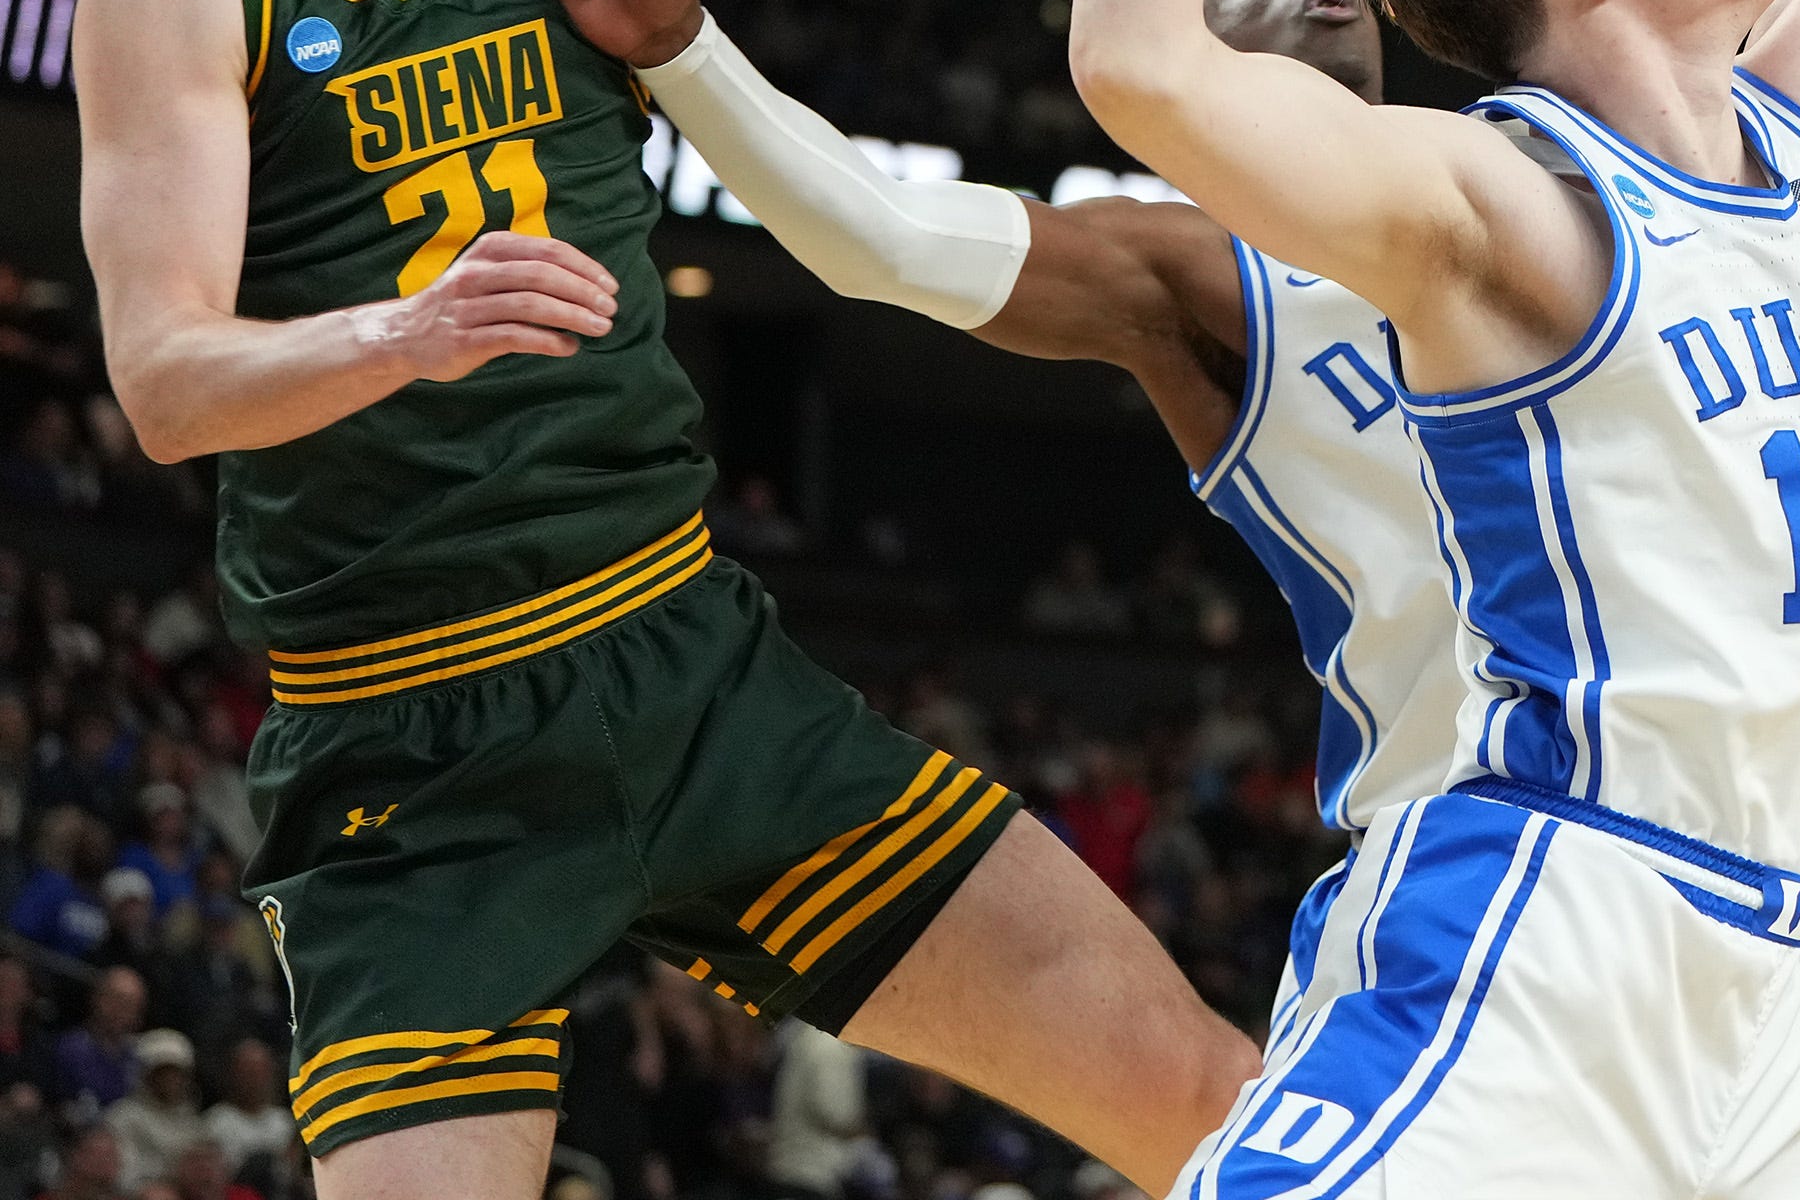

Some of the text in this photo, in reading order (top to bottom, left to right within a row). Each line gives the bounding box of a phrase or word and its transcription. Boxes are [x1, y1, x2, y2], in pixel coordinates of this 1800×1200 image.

[295, 39, 341, 62] NCAA
[345, 29, 553, 164] SIENA
[382, 138, 551, 298] 21
